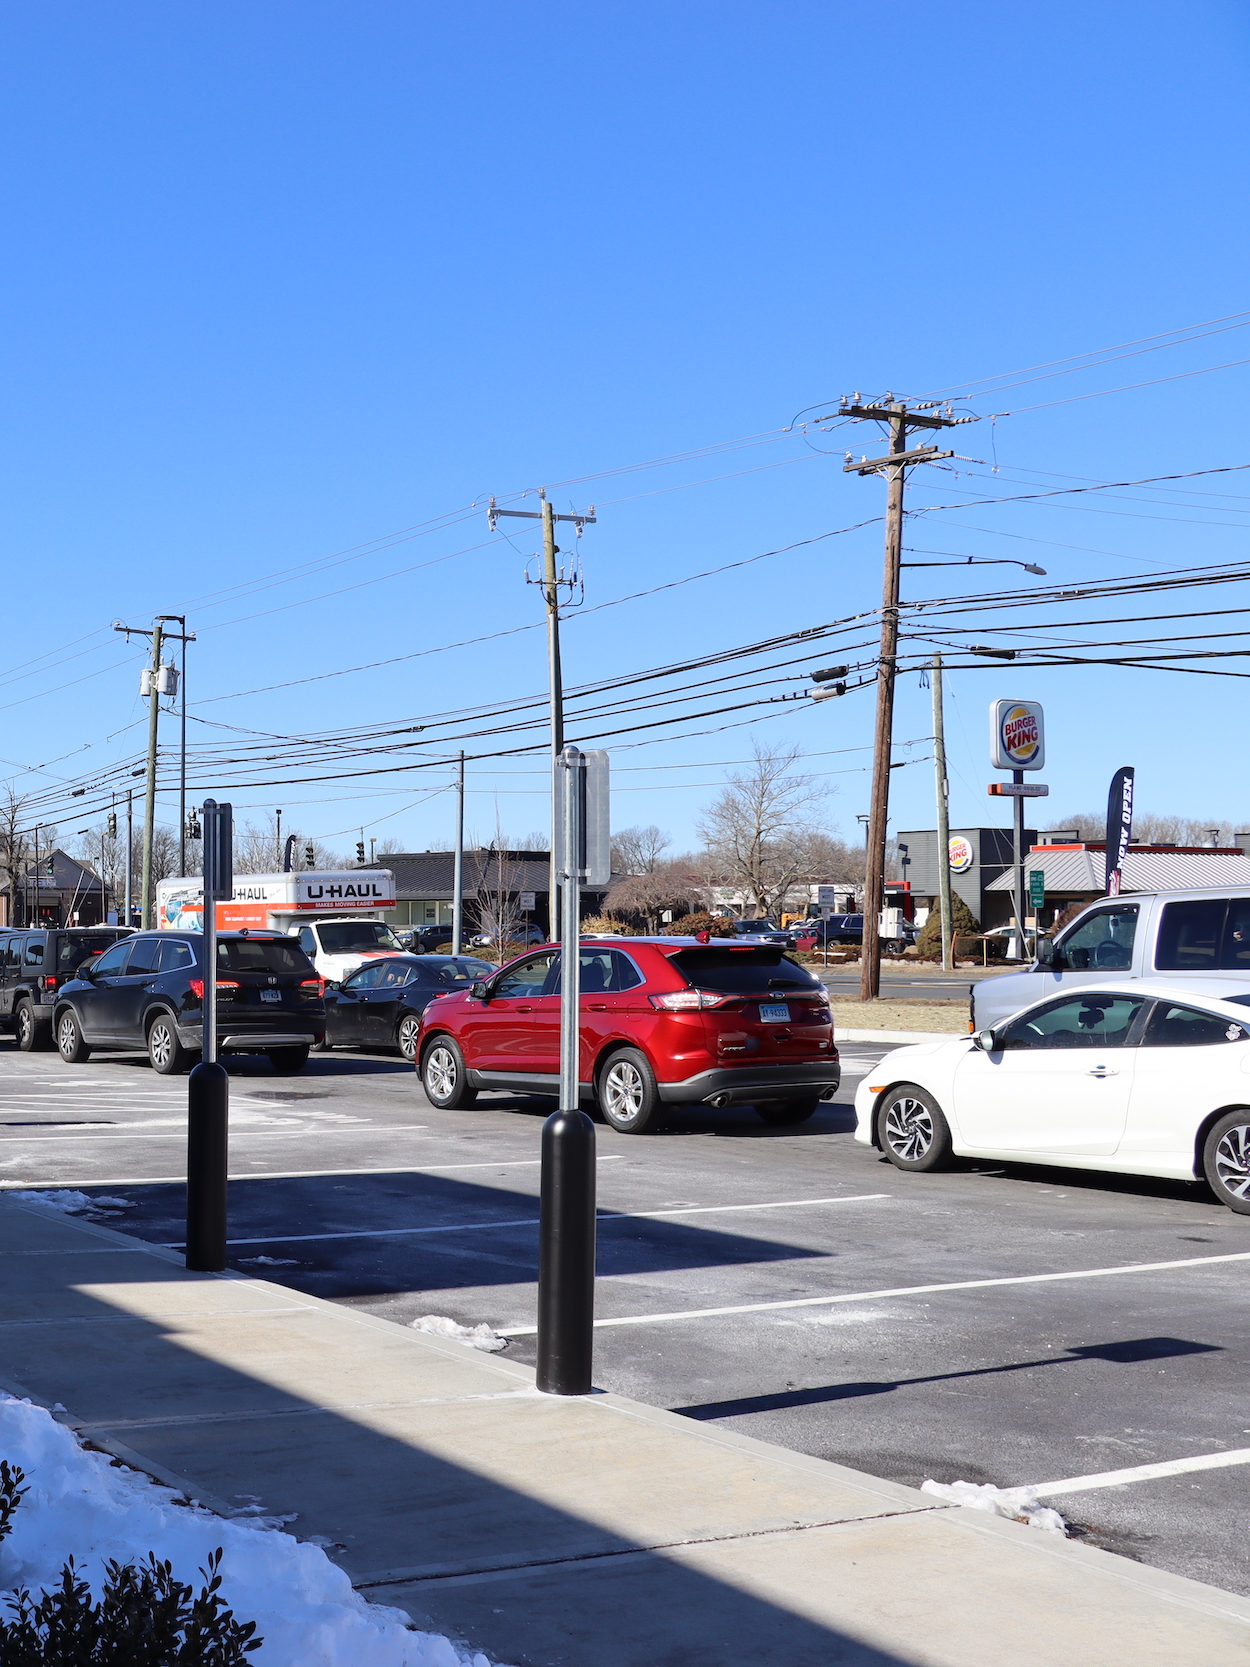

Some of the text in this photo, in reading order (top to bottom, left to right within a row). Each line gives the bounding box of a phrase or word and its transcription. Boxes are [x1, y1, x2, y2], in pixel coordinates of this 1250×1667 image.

[1005, 715, 1037, 736] BURGER
[1007, 726, 1038, 752] KING
[1116, 775, 1133, 870] NOW OPEN
[307, 883, 383, 899] U-HAUL
